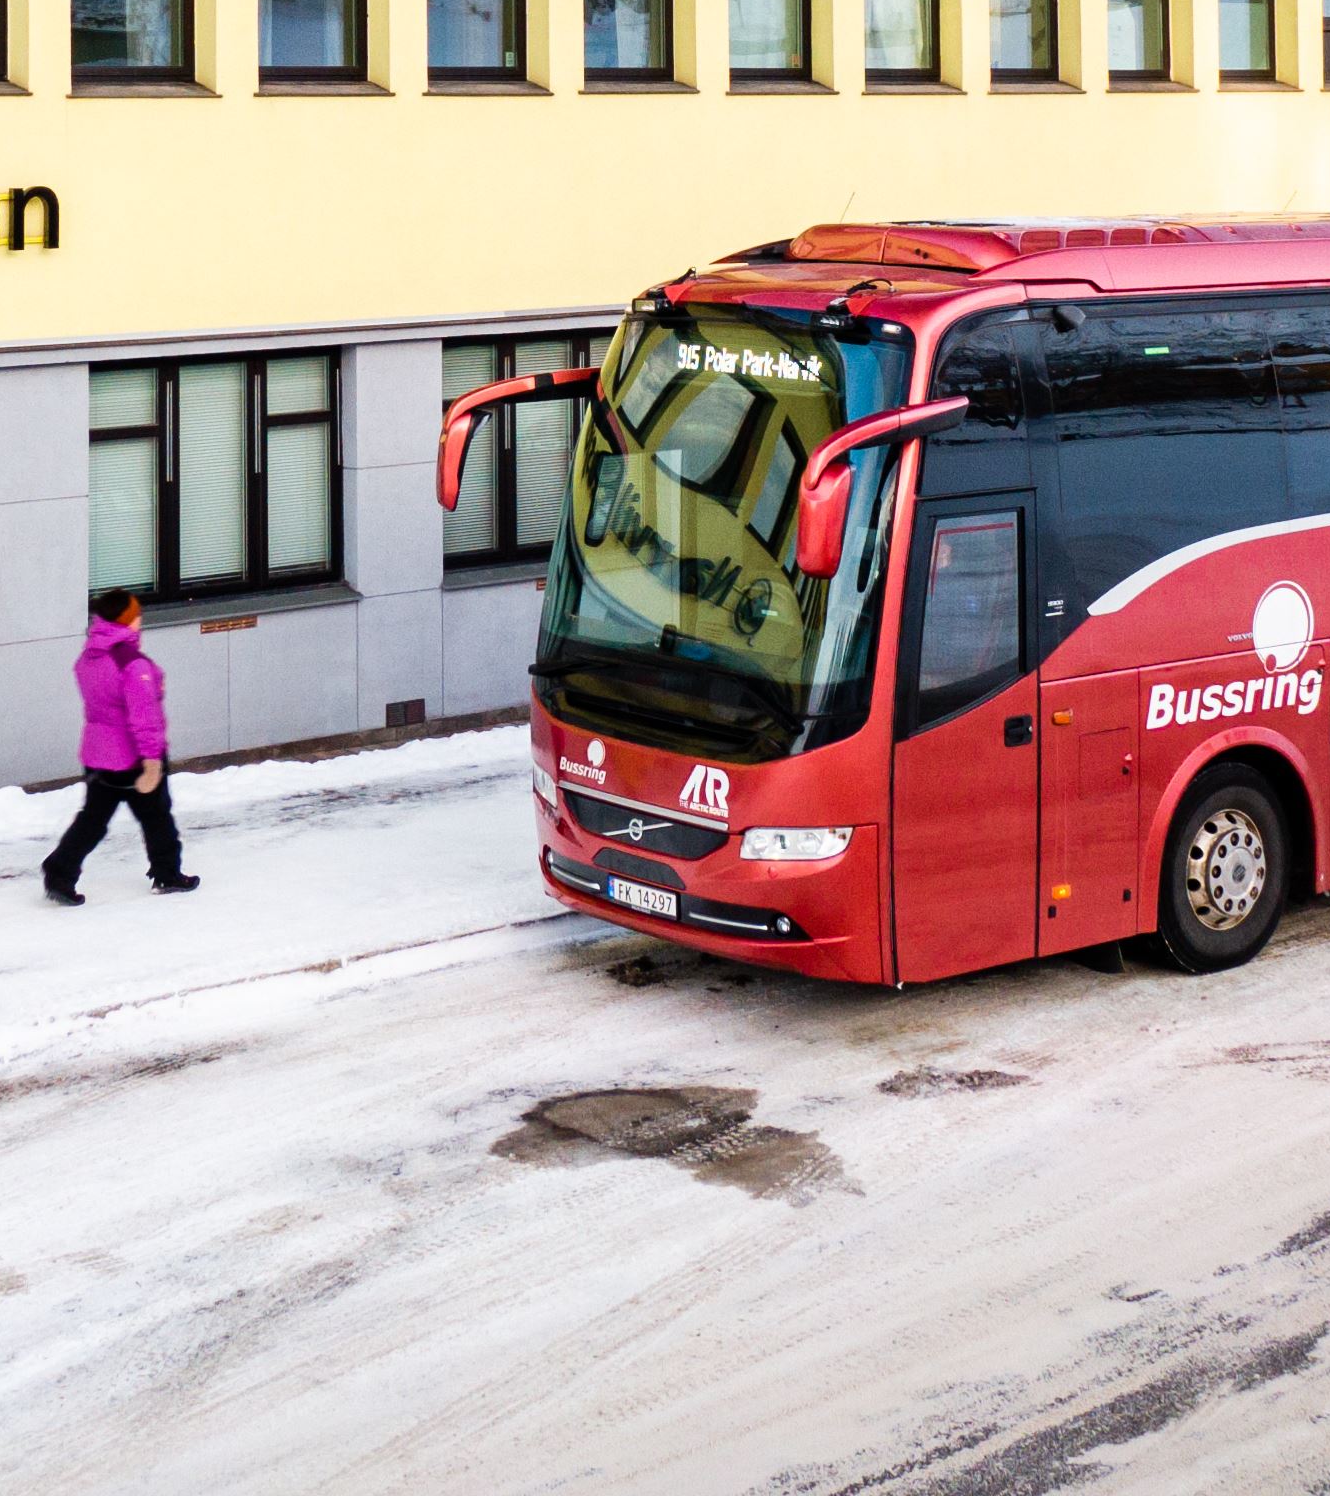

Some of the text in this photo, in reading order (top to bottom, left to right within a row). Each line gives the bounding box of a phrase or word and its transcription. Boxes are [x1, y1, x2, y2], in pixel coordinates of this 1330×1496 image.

[678, 343, 701, 370] 915
[705, 346, 739, 374] Polar
[1146, 669, 1323, 730] Bussring
[559, 756, 607, 785] Bussring
[679, 764, 731, 810] AR
[618, 883, 632, 903] FK
[638, 889, 673, 912] 14297
